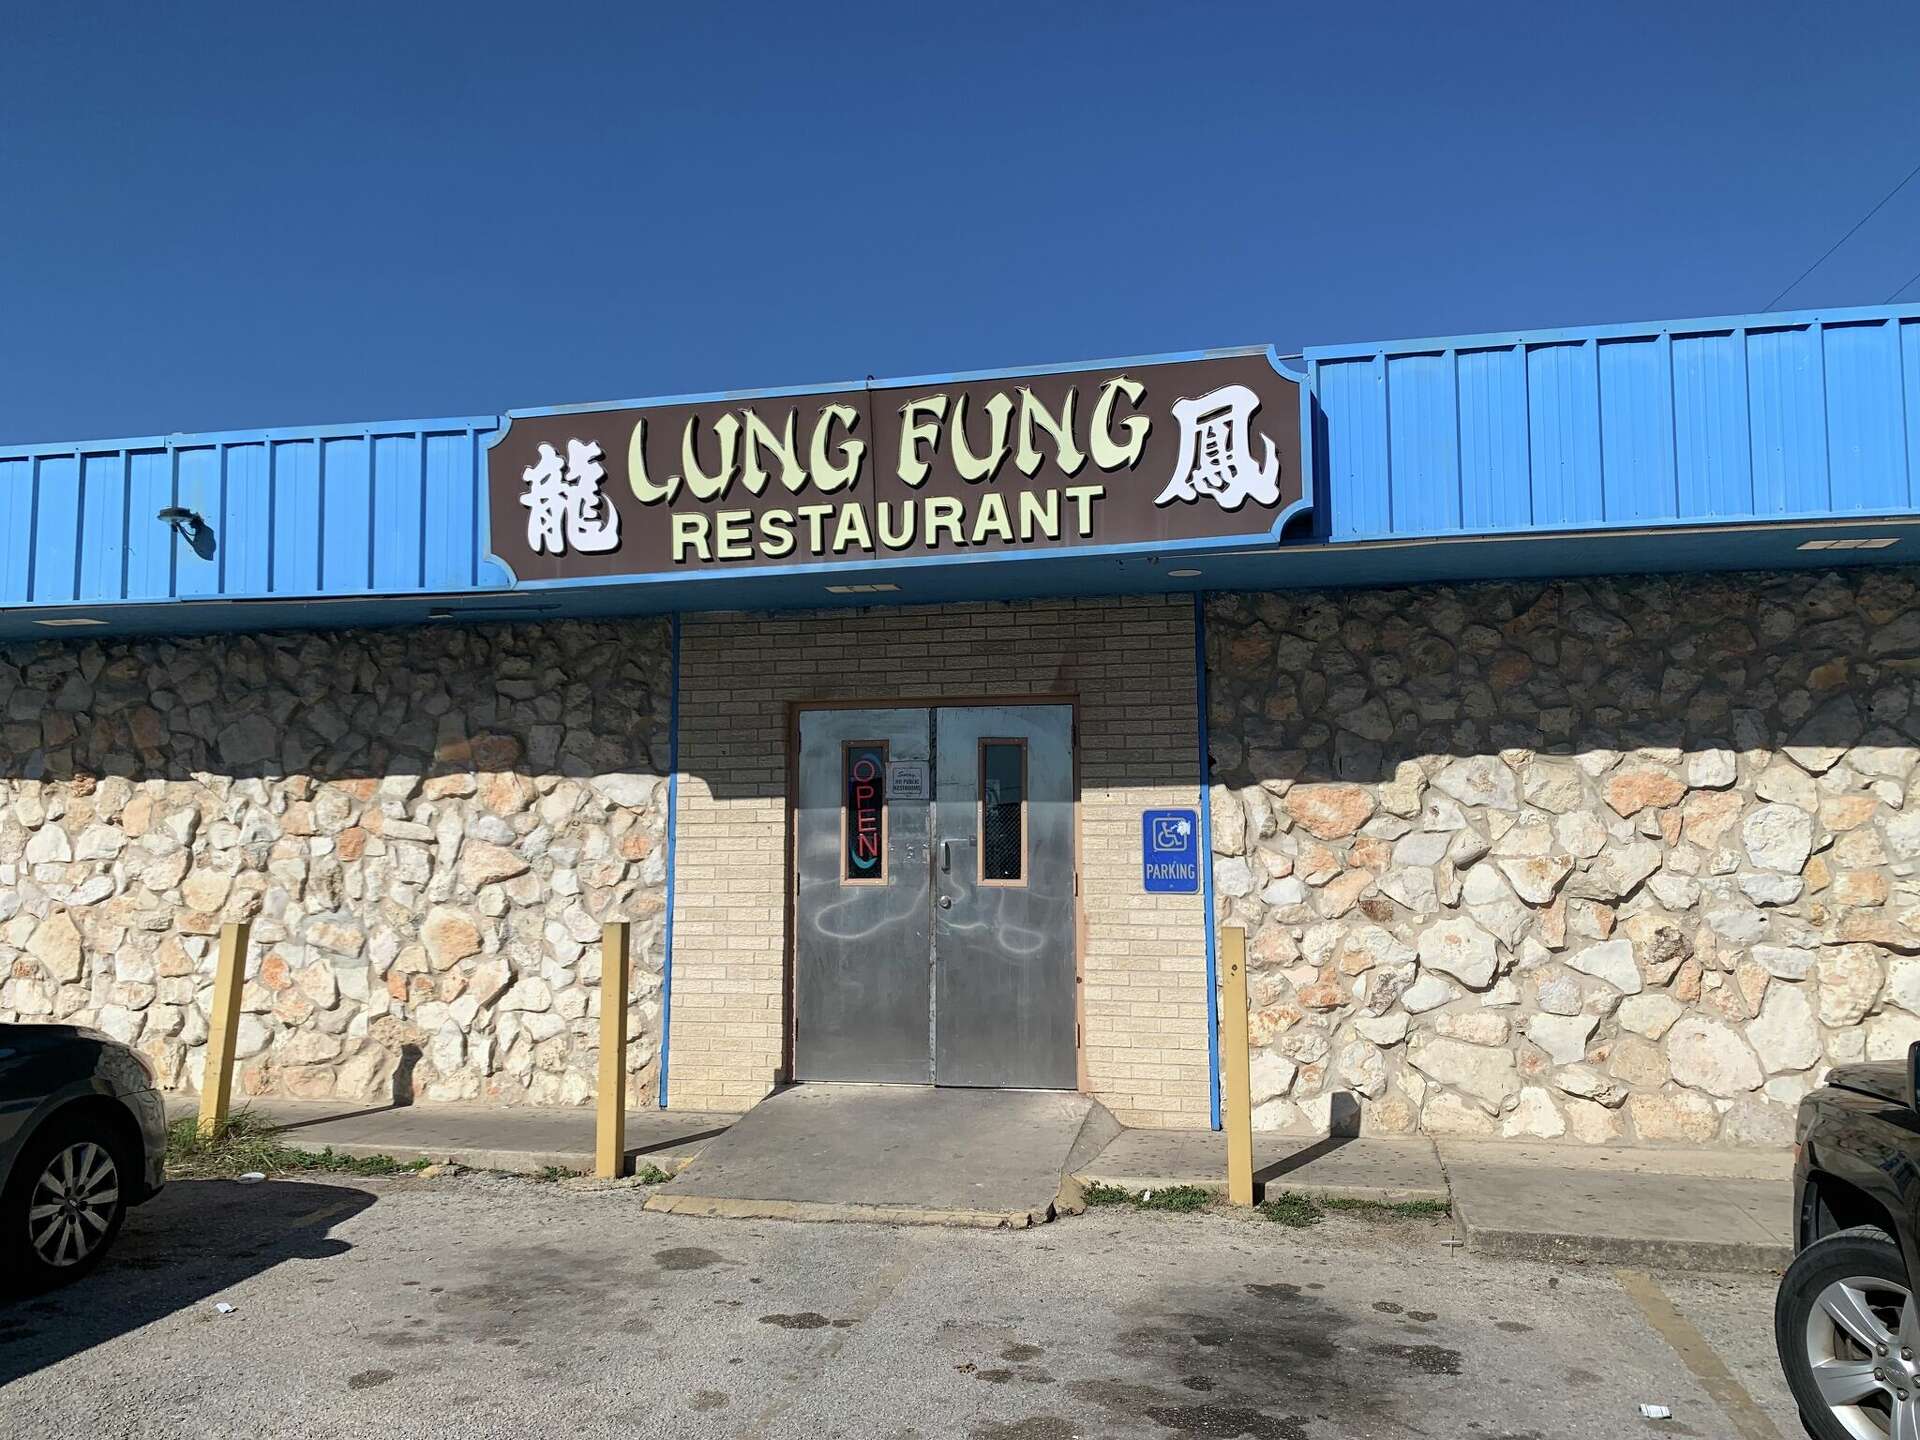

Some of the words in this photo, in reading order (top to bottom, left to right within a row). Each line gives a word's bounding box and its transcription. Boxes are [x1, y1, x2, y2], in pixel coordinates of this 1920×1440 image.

[627, 402, 866, 504] LUNG
[897, 374, 1150, 487] FUNG
[1154, 384, 1281, 509] 鳳
[519, 438, 621, 555] 龍
[672, 484, 1104, 562] RESTAURANT
[853, 760, 879, 857] OPEN
[1146, 863, 1196, 879] PARKING
